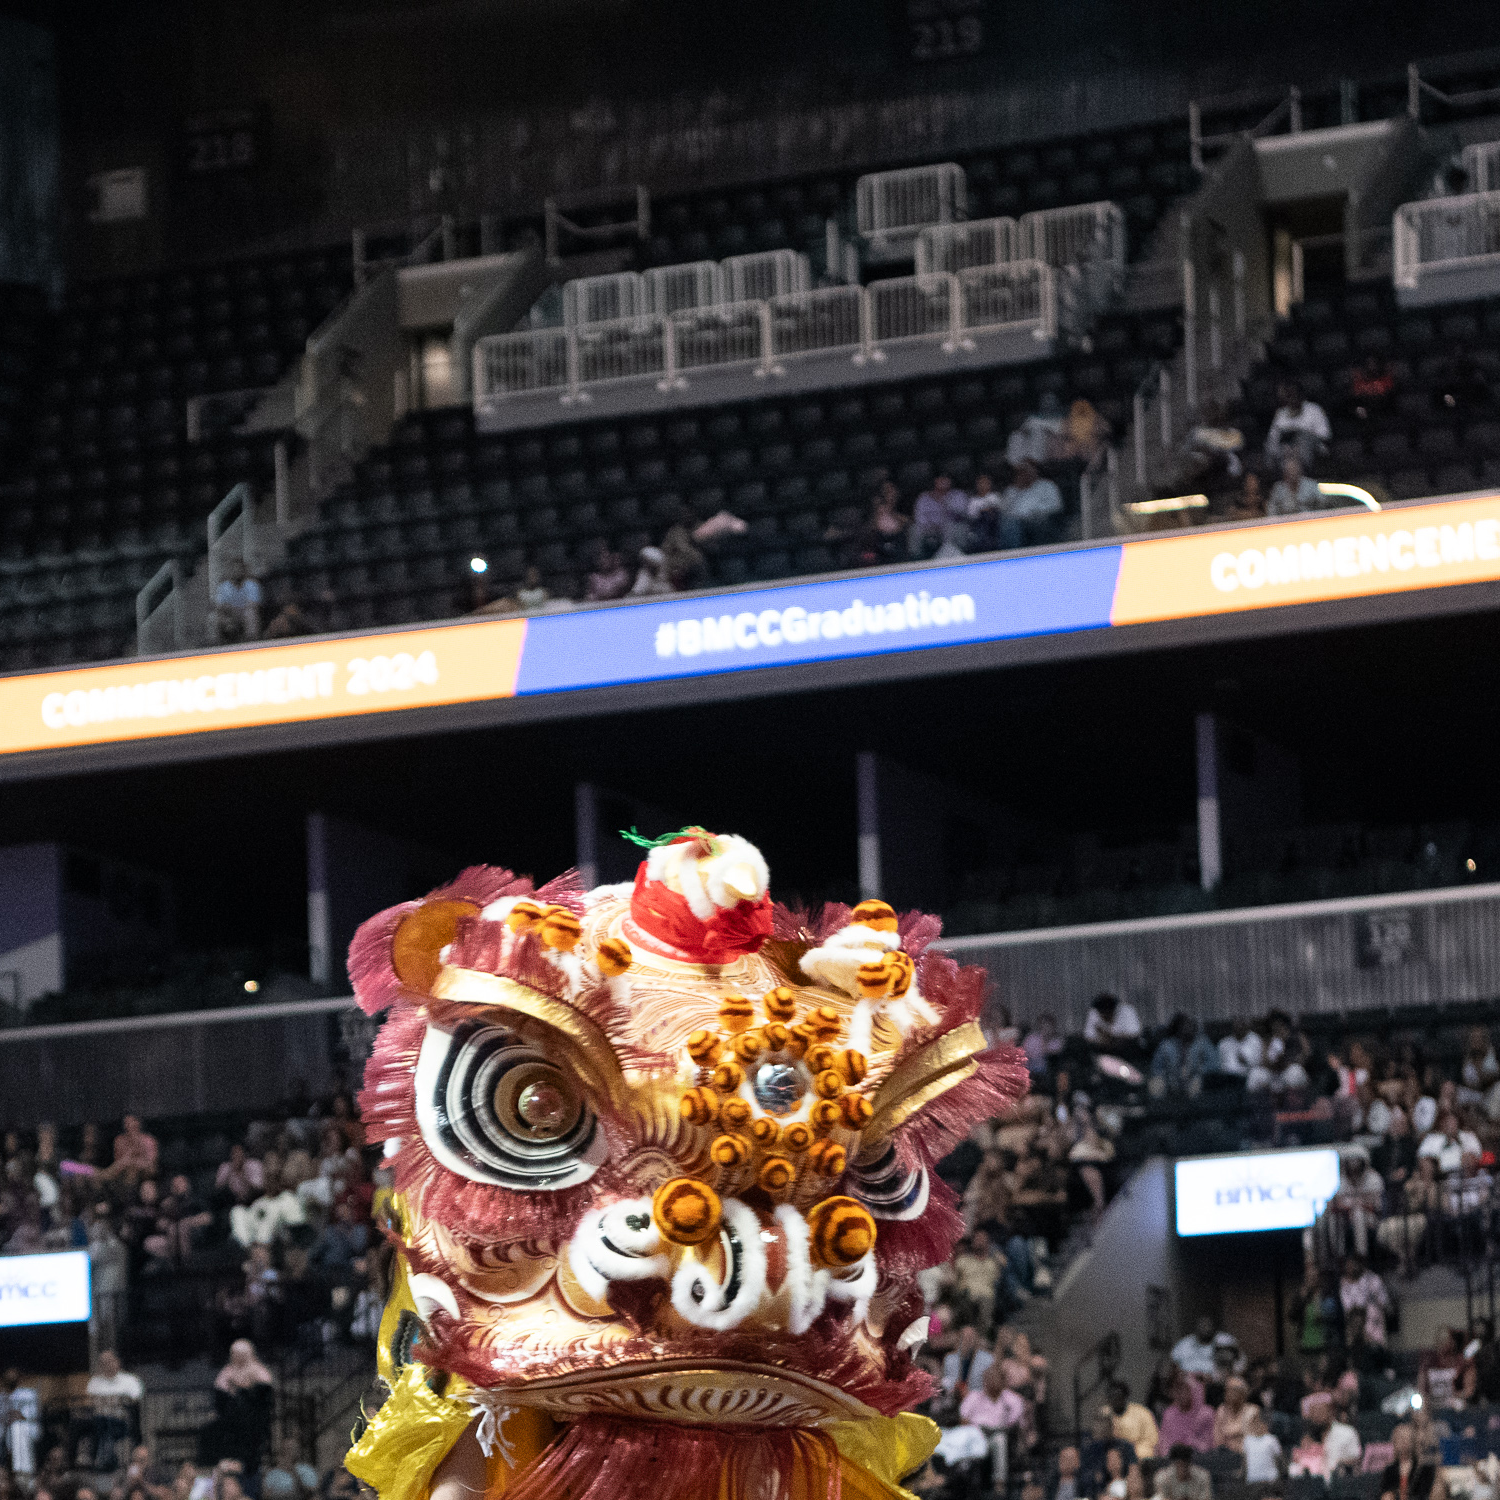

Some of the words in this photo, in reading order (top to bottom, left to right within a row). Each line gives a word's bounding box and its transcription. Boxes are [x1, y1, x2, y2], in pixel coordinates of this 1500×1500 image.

[653, 590, 976, 659] #BMCCGraduation
[41, 660, 336, 732] COMMENCEMENT
[347, 649, 439, 699] 2024
